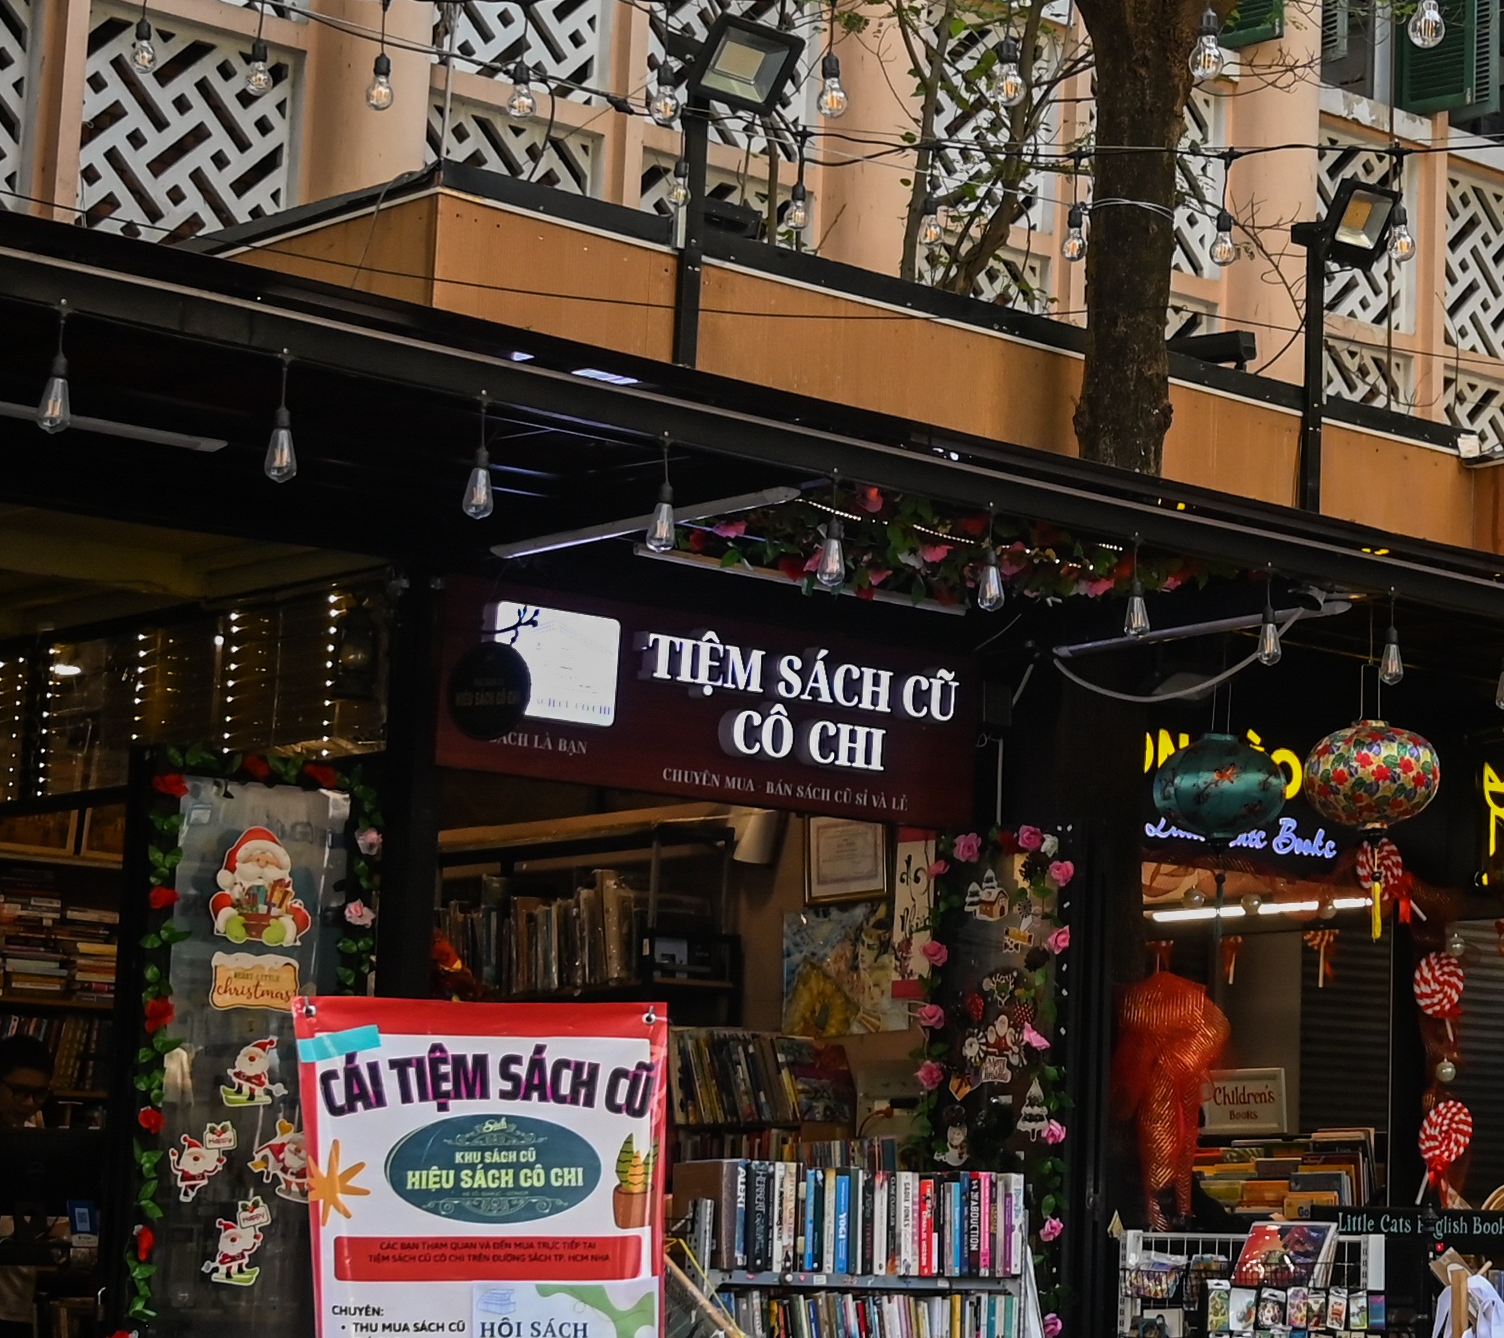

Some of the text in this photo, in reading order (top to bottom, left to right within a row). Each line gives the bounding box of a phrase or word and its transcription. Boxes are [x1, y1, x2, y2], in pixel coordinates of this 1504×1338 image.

[649, 630, 960, 722] TIỆM SÁCH CŨ
[533, 732, 588, 756] LÀ BẠN
[733, 703, 887, 772] CÔ CHI
[662, 767, 720, 788] CHUYÊN
[724, 776, 755, 792] MUA
[766, 779, 793, 796] BÁN
[796, 782, 831, 802] SÁCH
[834, 786, 853, 804] CŨ
[871, 791, 888, 810] VÀ
[217, 976, 292, 1003] christmas
[319, 1042, 658, 1119] CÁI TIỆM SÁCH CŨ
[1212, 1084, 1275, 1107] Children's
[455, 1147, 536, 1164] KHU SÁCH CŨ
[406, 1163, 584, 1191] HIỆU SÁCH CÔ CHI
[970, 1201, 979, 1251] ABDUCTION
[1338, 1212, 1375, 1232] Little
[1380, 1214, 1412, 1233] Cats
[332, 1305, 384, 1317] CHUYÊN:
[352, 1319, 466, 1333] THU MUA SÁCH CŨ
[530, 1318, 589, 1338] SÁCH
